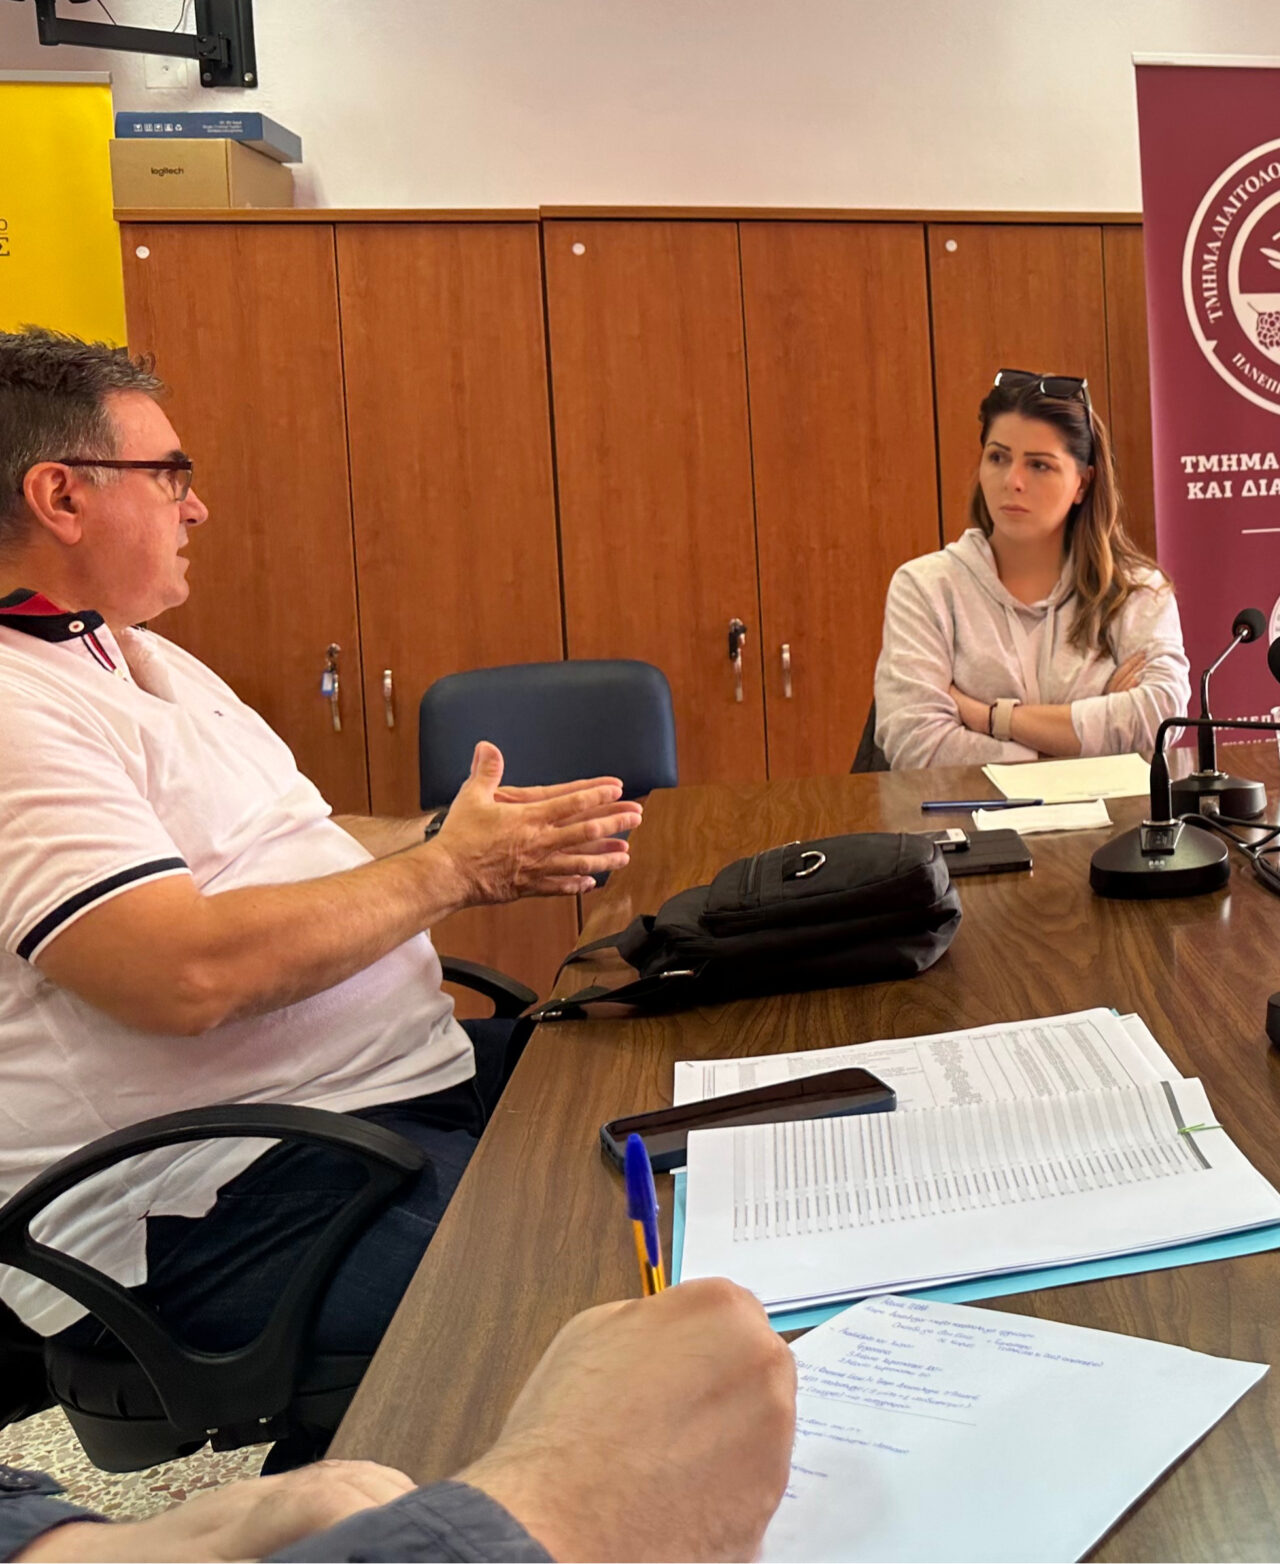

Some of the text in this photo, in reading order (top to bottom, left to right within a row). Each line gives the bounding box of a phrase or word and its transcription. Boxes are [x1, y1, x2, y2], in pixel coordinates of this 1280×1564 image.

[150, 167, 185, 177] logitech
[1202, 240, 1224, 323] ΤΜΗΜΑ
[1181, 452, 1280, 473] ΤΜΗΜΑ
[1187, 480, 1233, 500] ΚΑΙ
